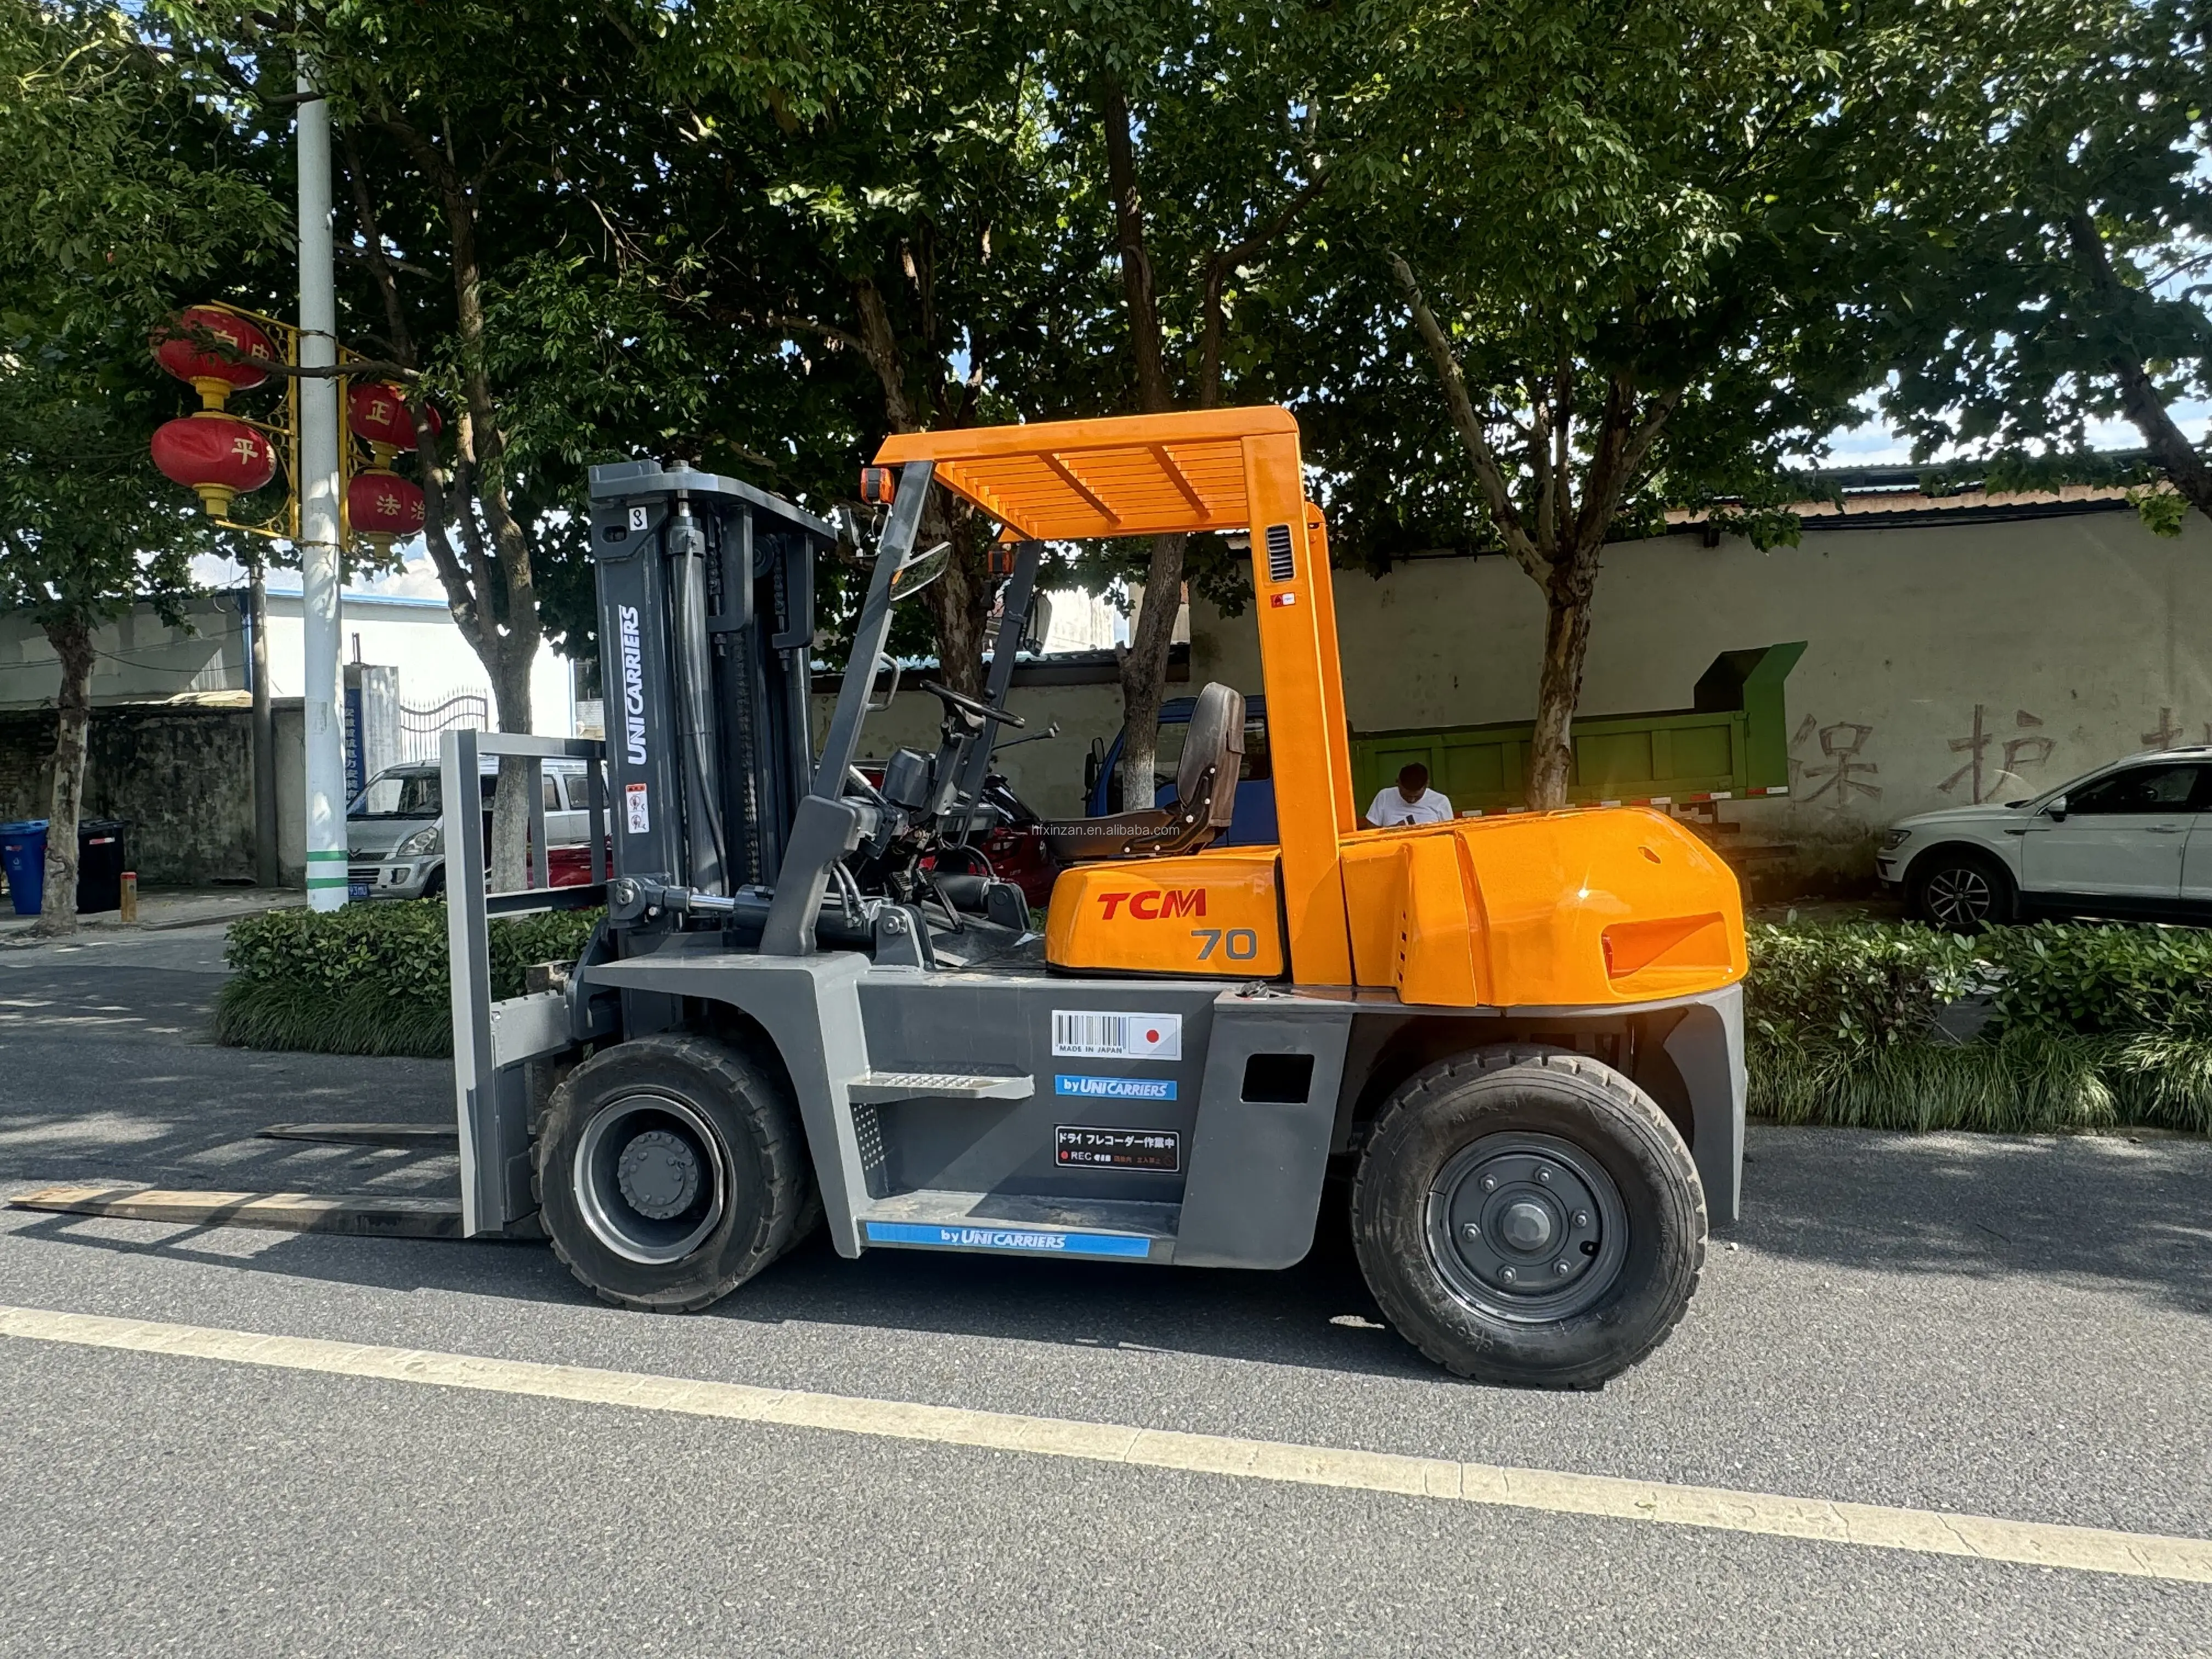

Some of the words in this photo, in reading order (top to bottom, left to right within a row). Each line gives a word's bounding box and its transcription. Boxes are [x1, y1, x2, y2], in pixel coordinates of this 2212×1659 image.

[618, 605, 647, 765] UNICARRIERS
[1788, 704, 2212, 810] 保护
[1097, 888, 1206, 920] TCM
[1190, 928, 1257, 960] 70
[1064, 1079, 1079, 1092] by
[1080, 1079, 1168, 1096] UNICARRIERS
[1071, 1152, 1092, 1161] REC
[941, 1229, 959, 1243] by
[961, 1230, 1066, 1249] UNICARRIERS
